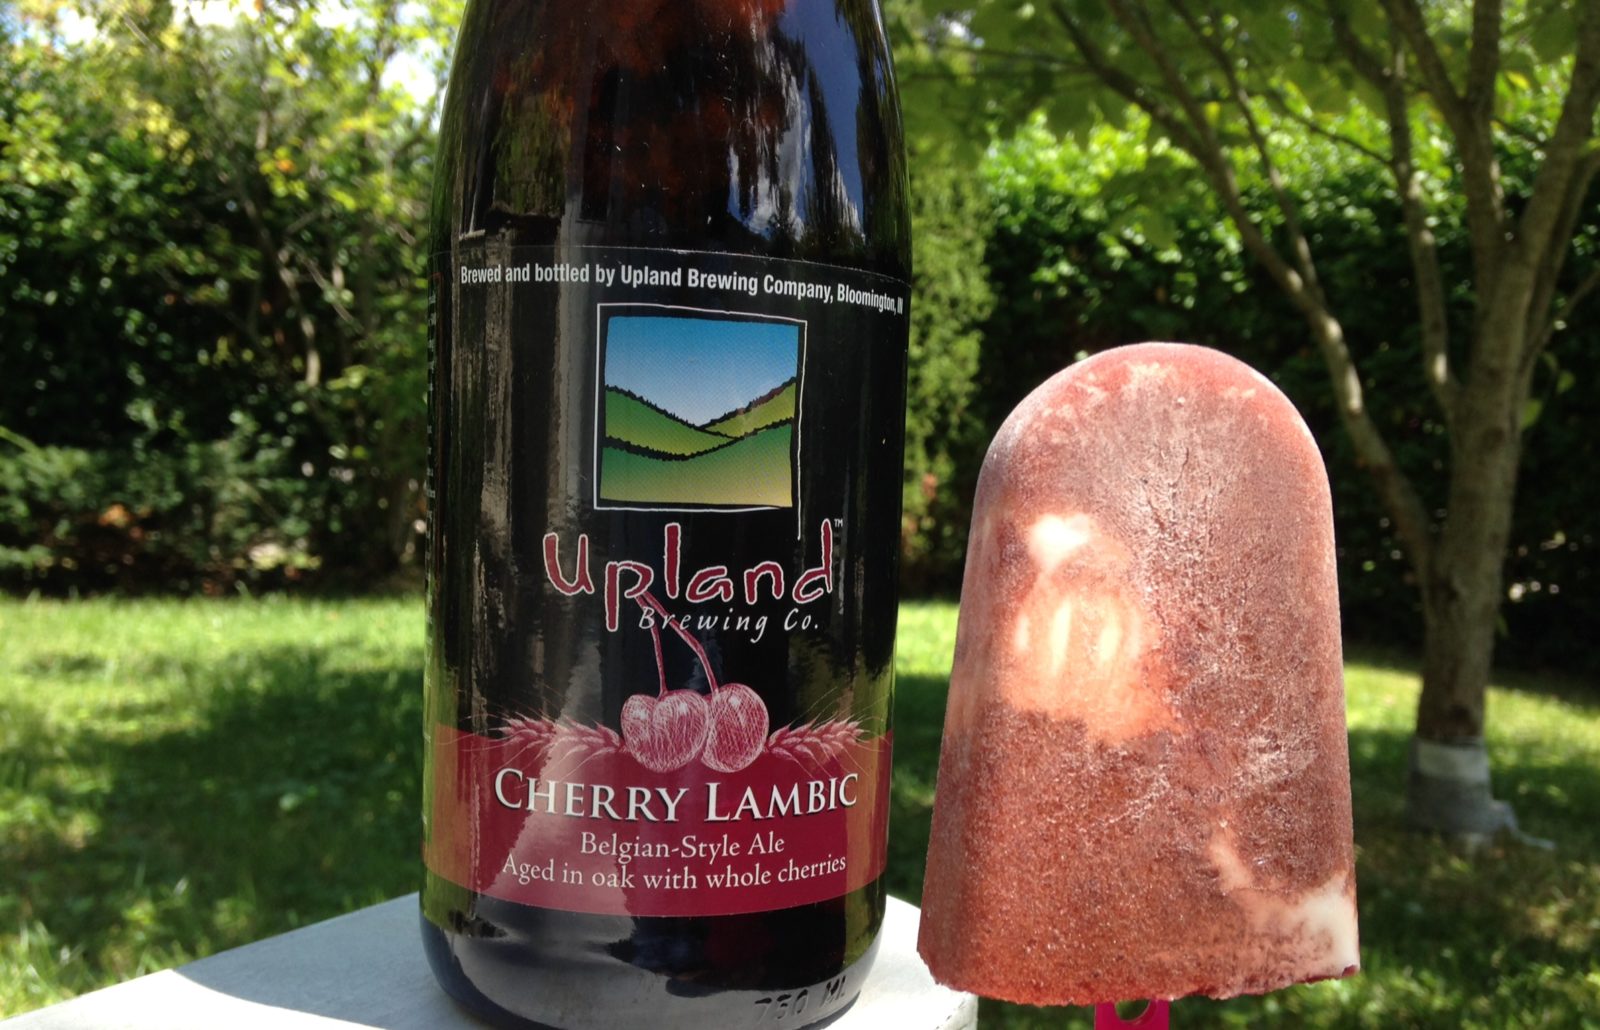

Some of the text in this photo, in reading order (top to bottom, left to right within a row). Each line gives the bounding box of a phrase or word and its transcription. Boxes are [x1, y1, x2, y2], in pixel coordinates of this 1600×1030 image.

[460, 265, 501, 284] Brewed
[505, 264, 531, 283] and
[534, 263, 590, 284] bottled
[595, 265, 616, 288] by
[620, 265, 682, 289] Upland
[687, 269, 758, 295] Brewing
[763, 275, 834, 304] Company,
[836, 282, 897, 316] Bloomington,
[638, 605, 819, 643] Brewing Co.
[494, 767, 860, 823] CHERRY LAMBIC
[580, 830, 785, 865] Belgian-Style Ale
[502, 853, 847, 890] Aged in oak with whole cherries
